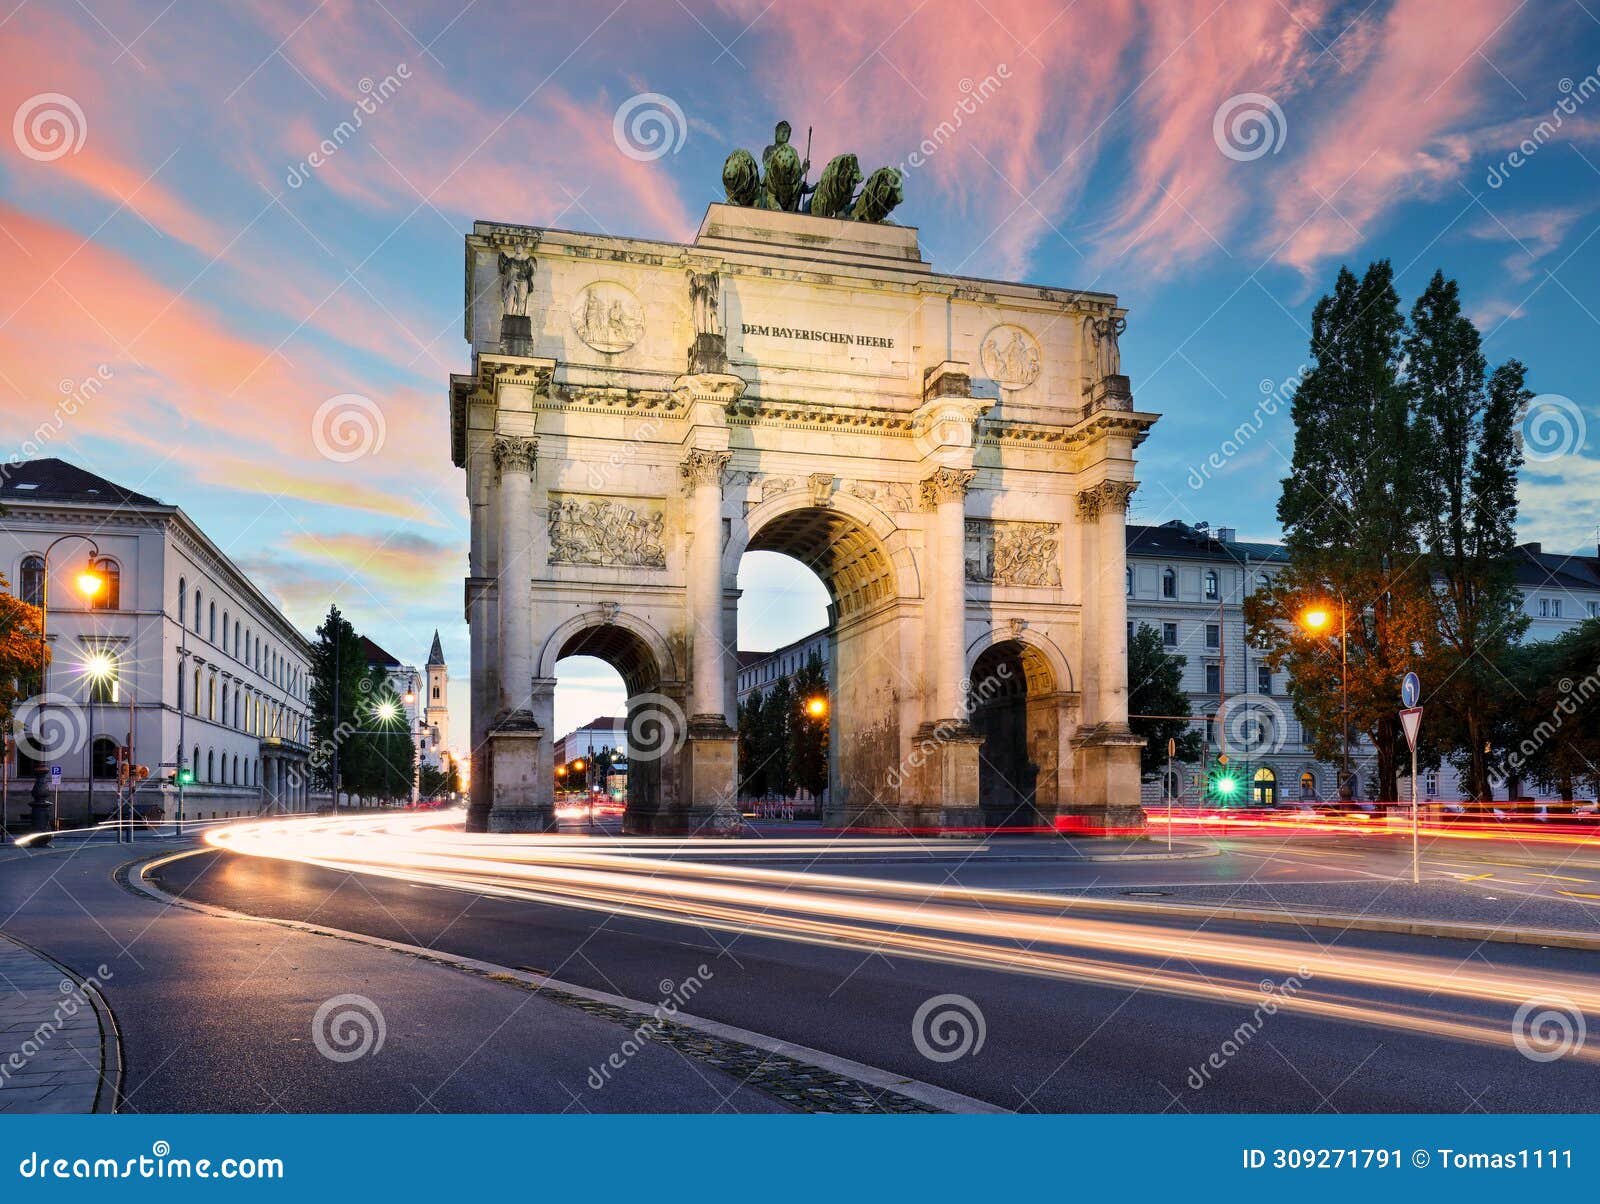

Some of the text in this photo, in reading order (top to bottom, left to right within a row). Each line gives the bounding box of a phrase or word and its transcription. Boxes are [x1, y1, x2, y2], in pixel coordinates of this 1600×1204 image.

[741, 323, 894, 348] DEM BAYERISCHEN HEERE
